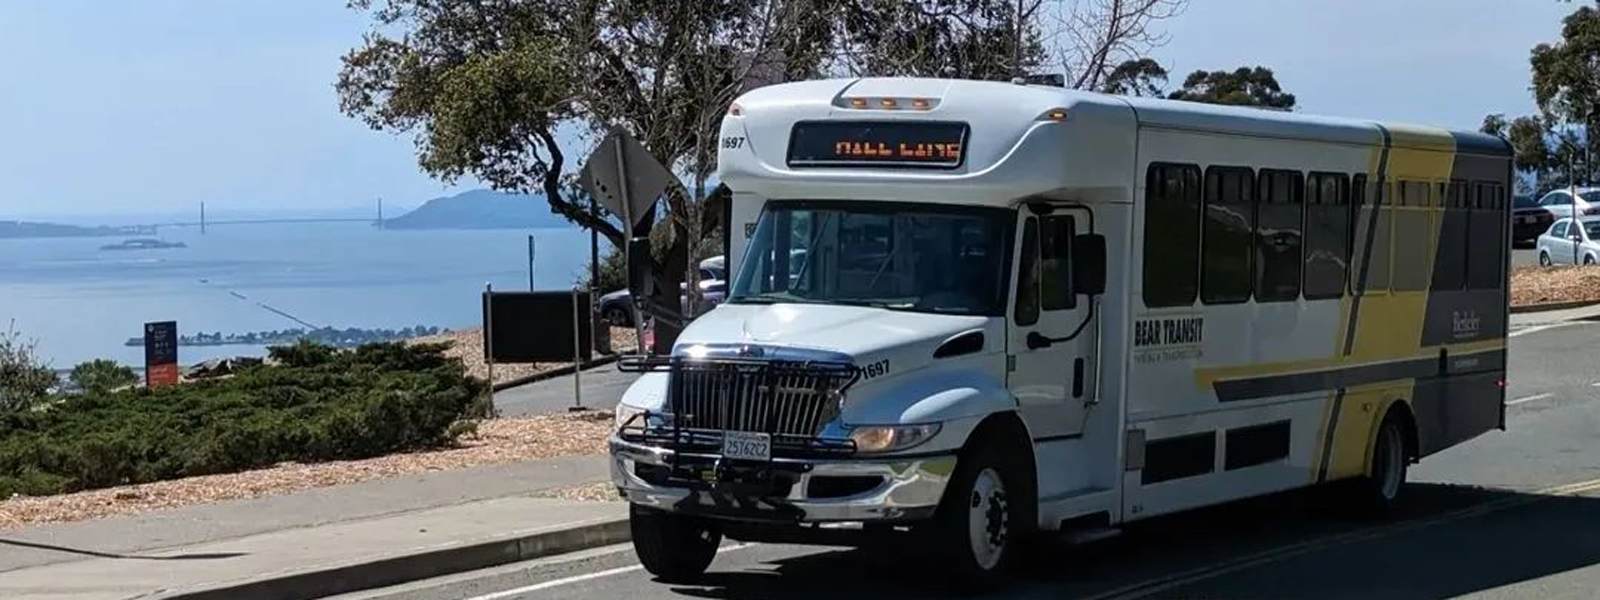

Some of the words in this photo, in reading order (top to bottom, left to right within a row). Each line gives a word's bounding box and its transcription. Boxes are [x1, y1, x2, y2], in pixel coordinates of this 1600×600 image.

[1134, 320, 1161, 347] BEAR
[1163, 318, 1204, 344] TRANSIT
[860, 359, 890, 380] 1697
